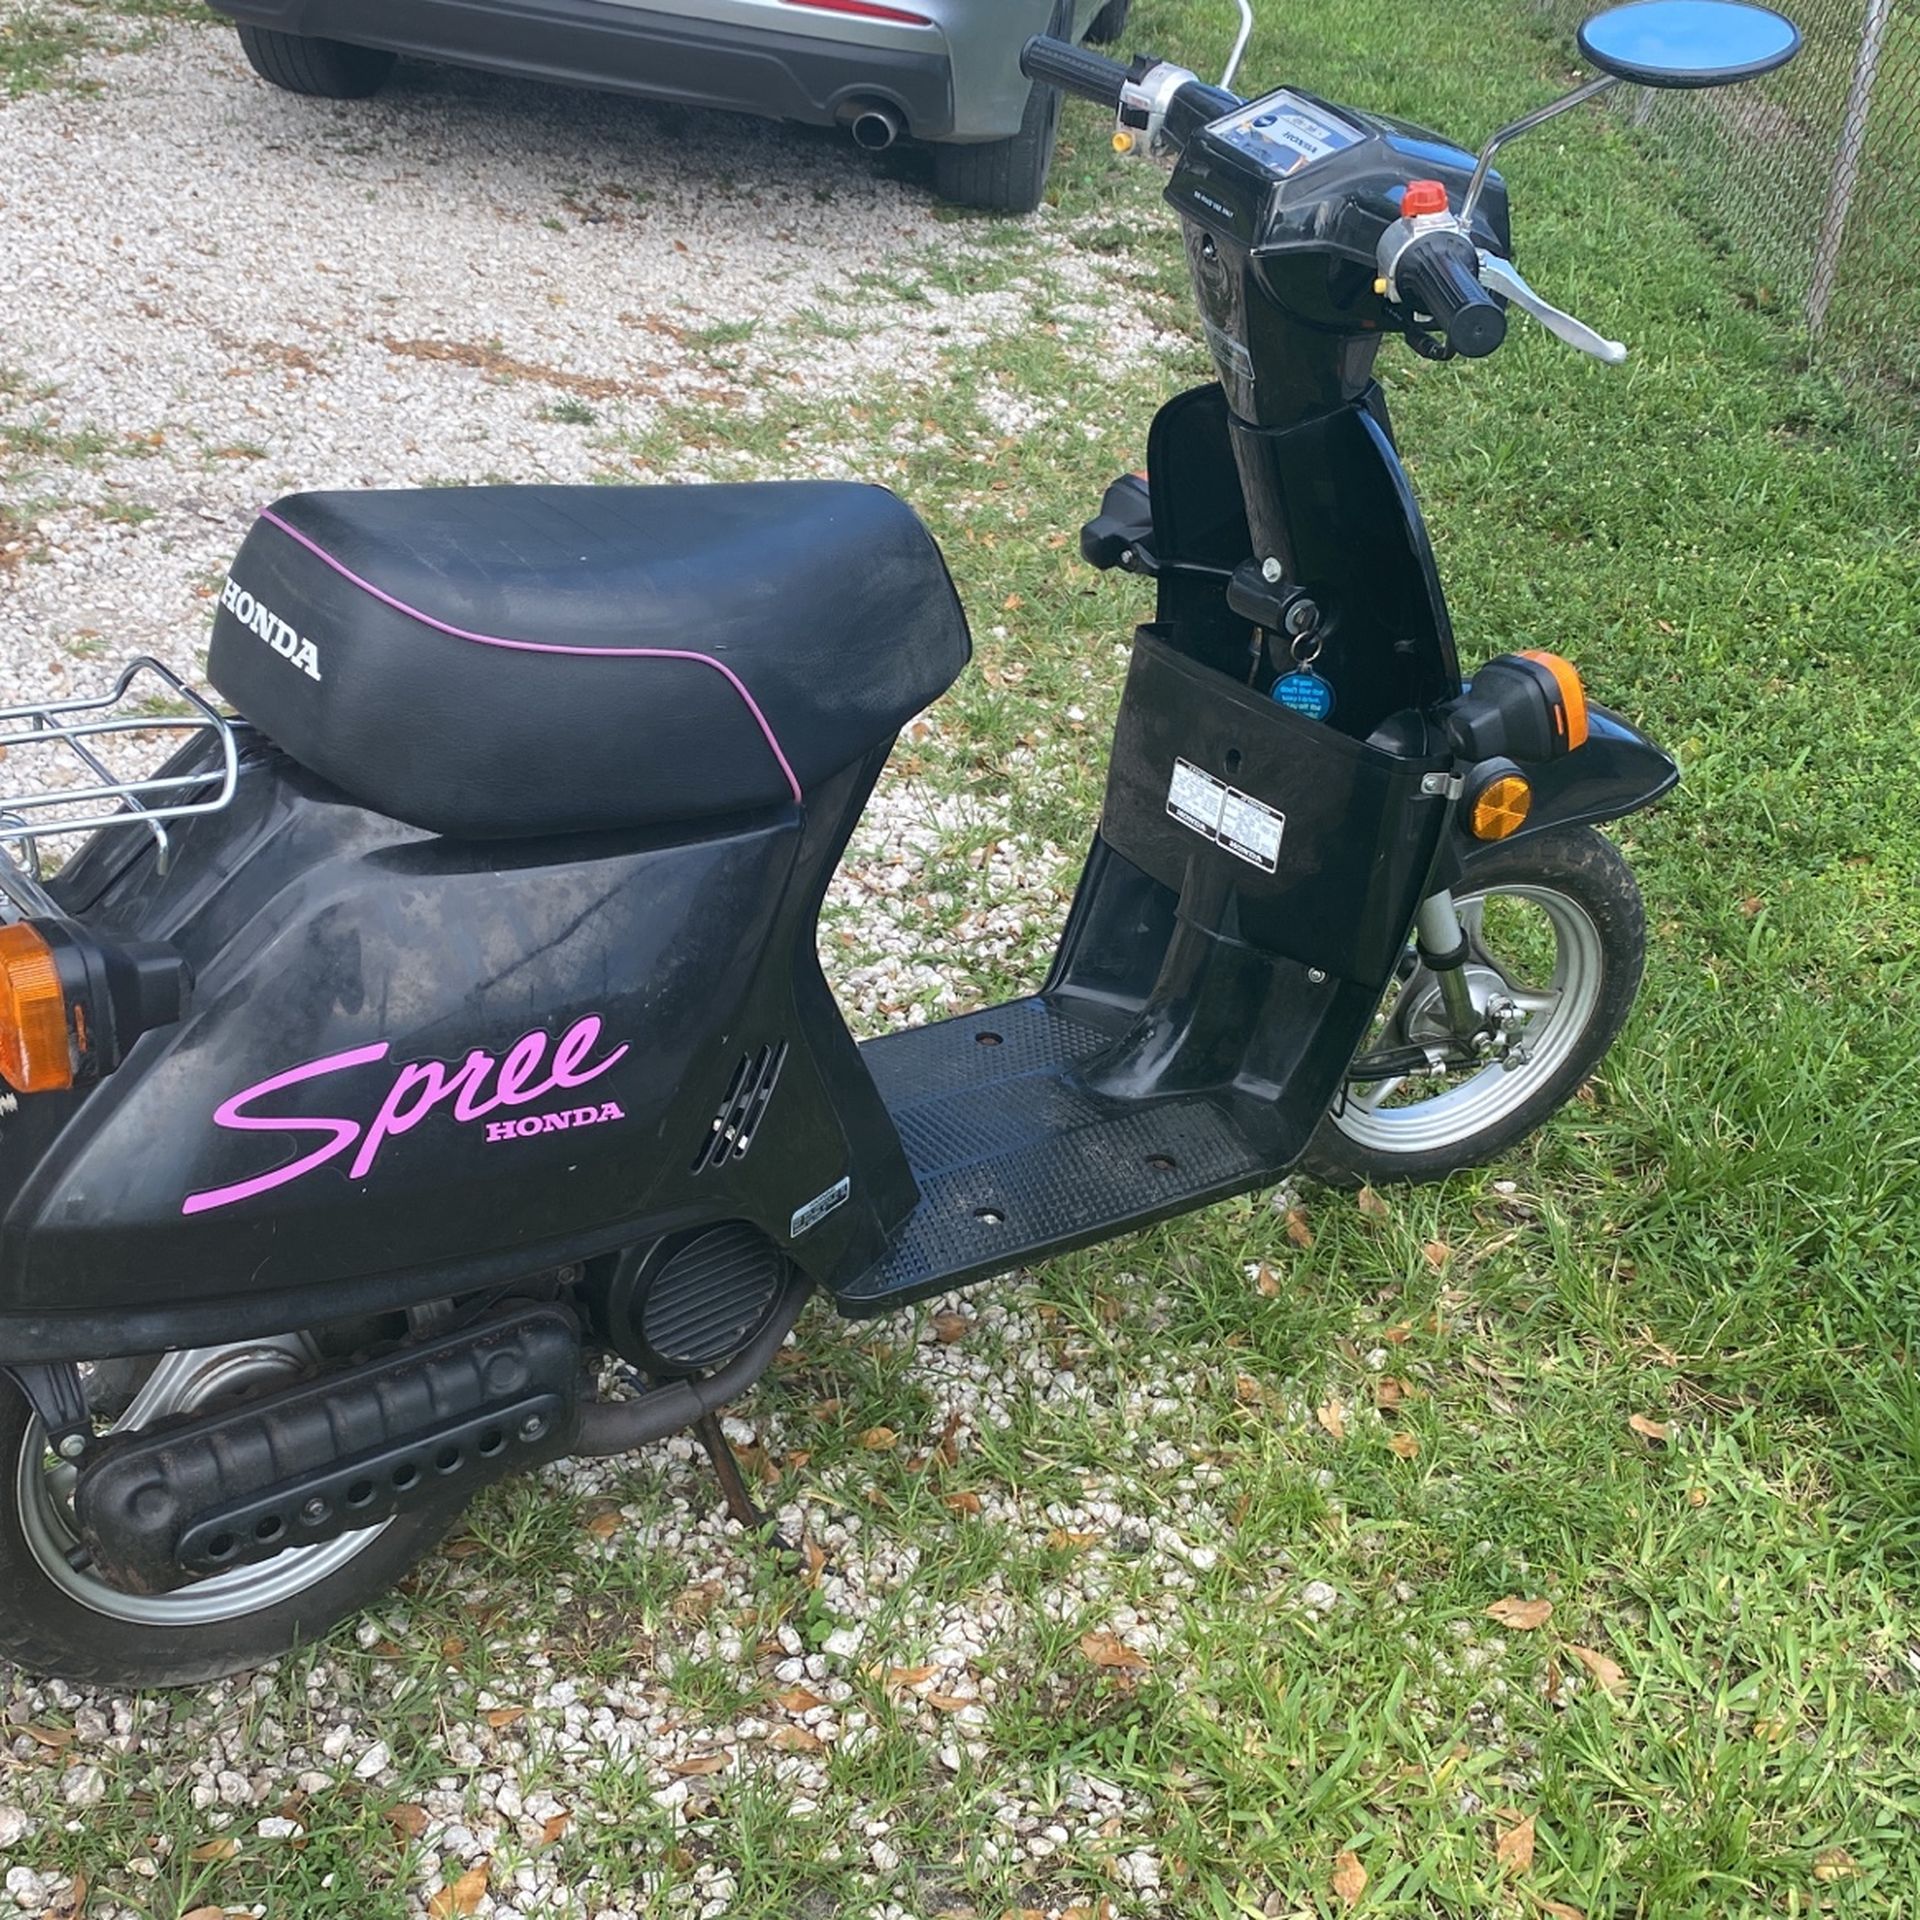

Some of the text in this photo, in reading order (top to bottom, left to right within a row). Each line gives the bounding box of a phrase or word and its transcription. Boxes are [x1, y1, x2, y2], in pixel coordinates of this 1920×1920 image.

[220, 575, 322, 682] HONDA
[181, 1012, 630, 1215] Spree
[485, 1099, 625, 1143] HONDA
